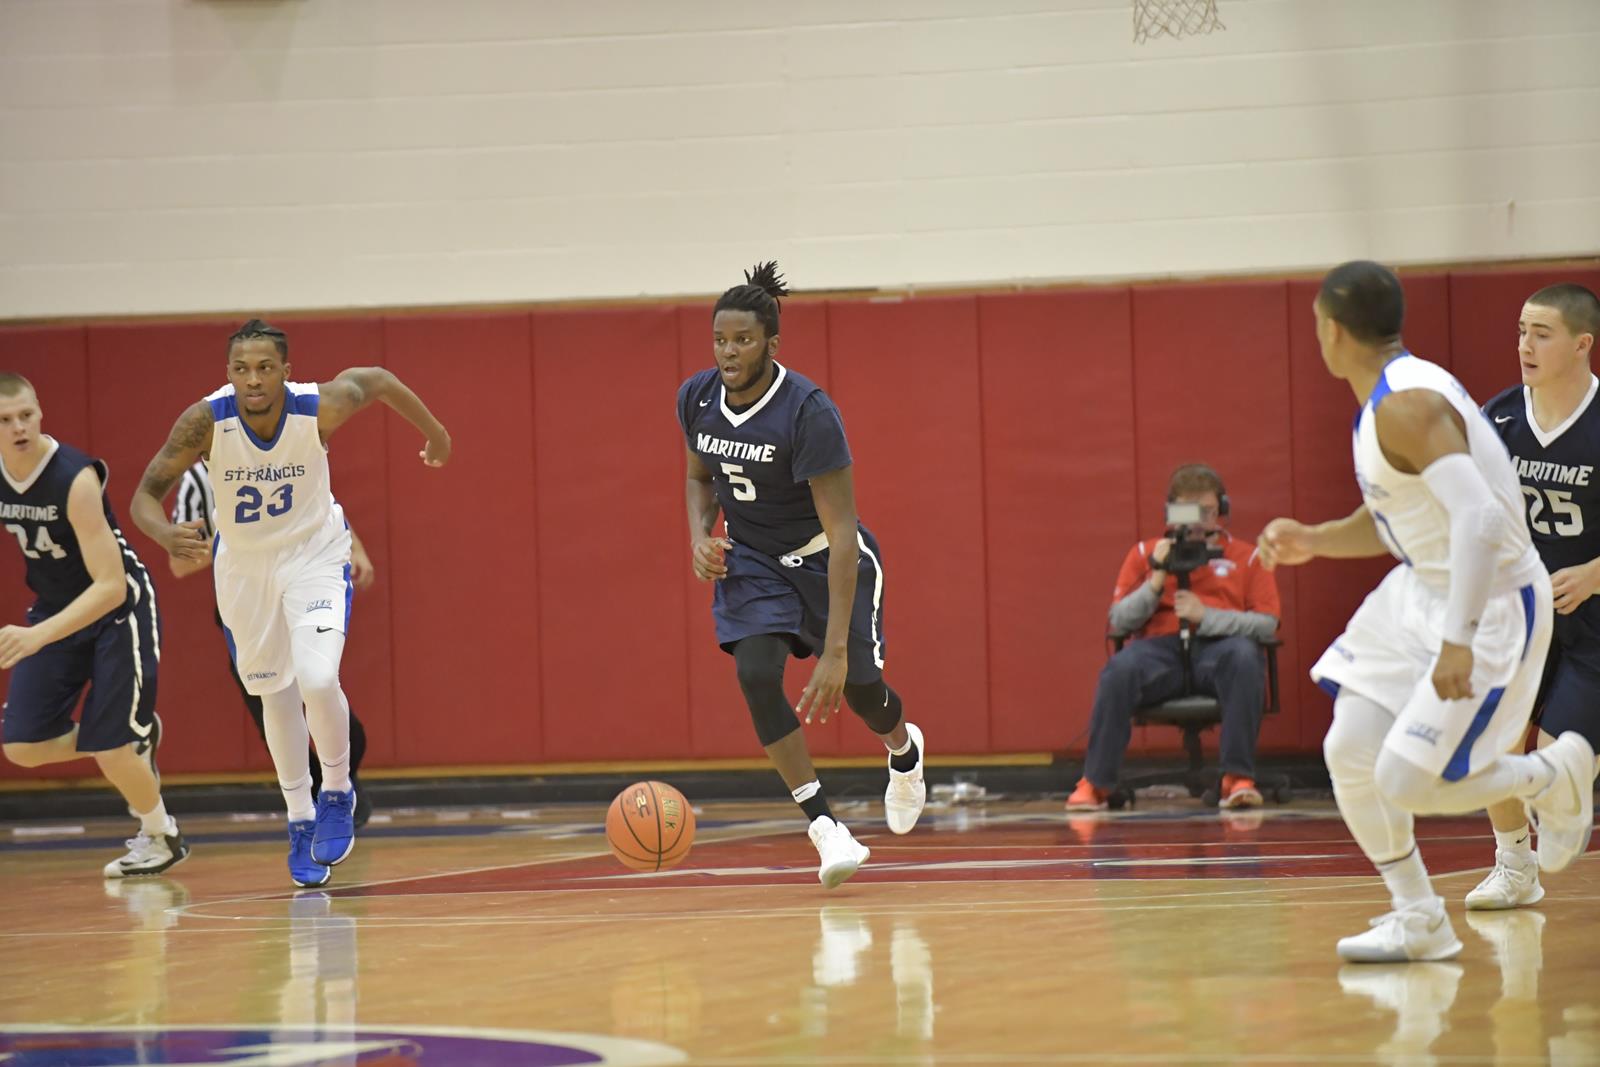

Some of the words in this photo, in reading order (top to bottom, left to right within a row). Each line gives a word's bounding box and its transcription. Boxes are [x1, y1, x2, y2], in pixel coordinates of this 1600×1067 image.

[697, 432, 776, 462] MARITIME
[720, 462, 756, 501] 5
[235, 483, 293, 523] 23
[1520, 485, 1584, 536] 25
[5, 524, 67, 559] 24
